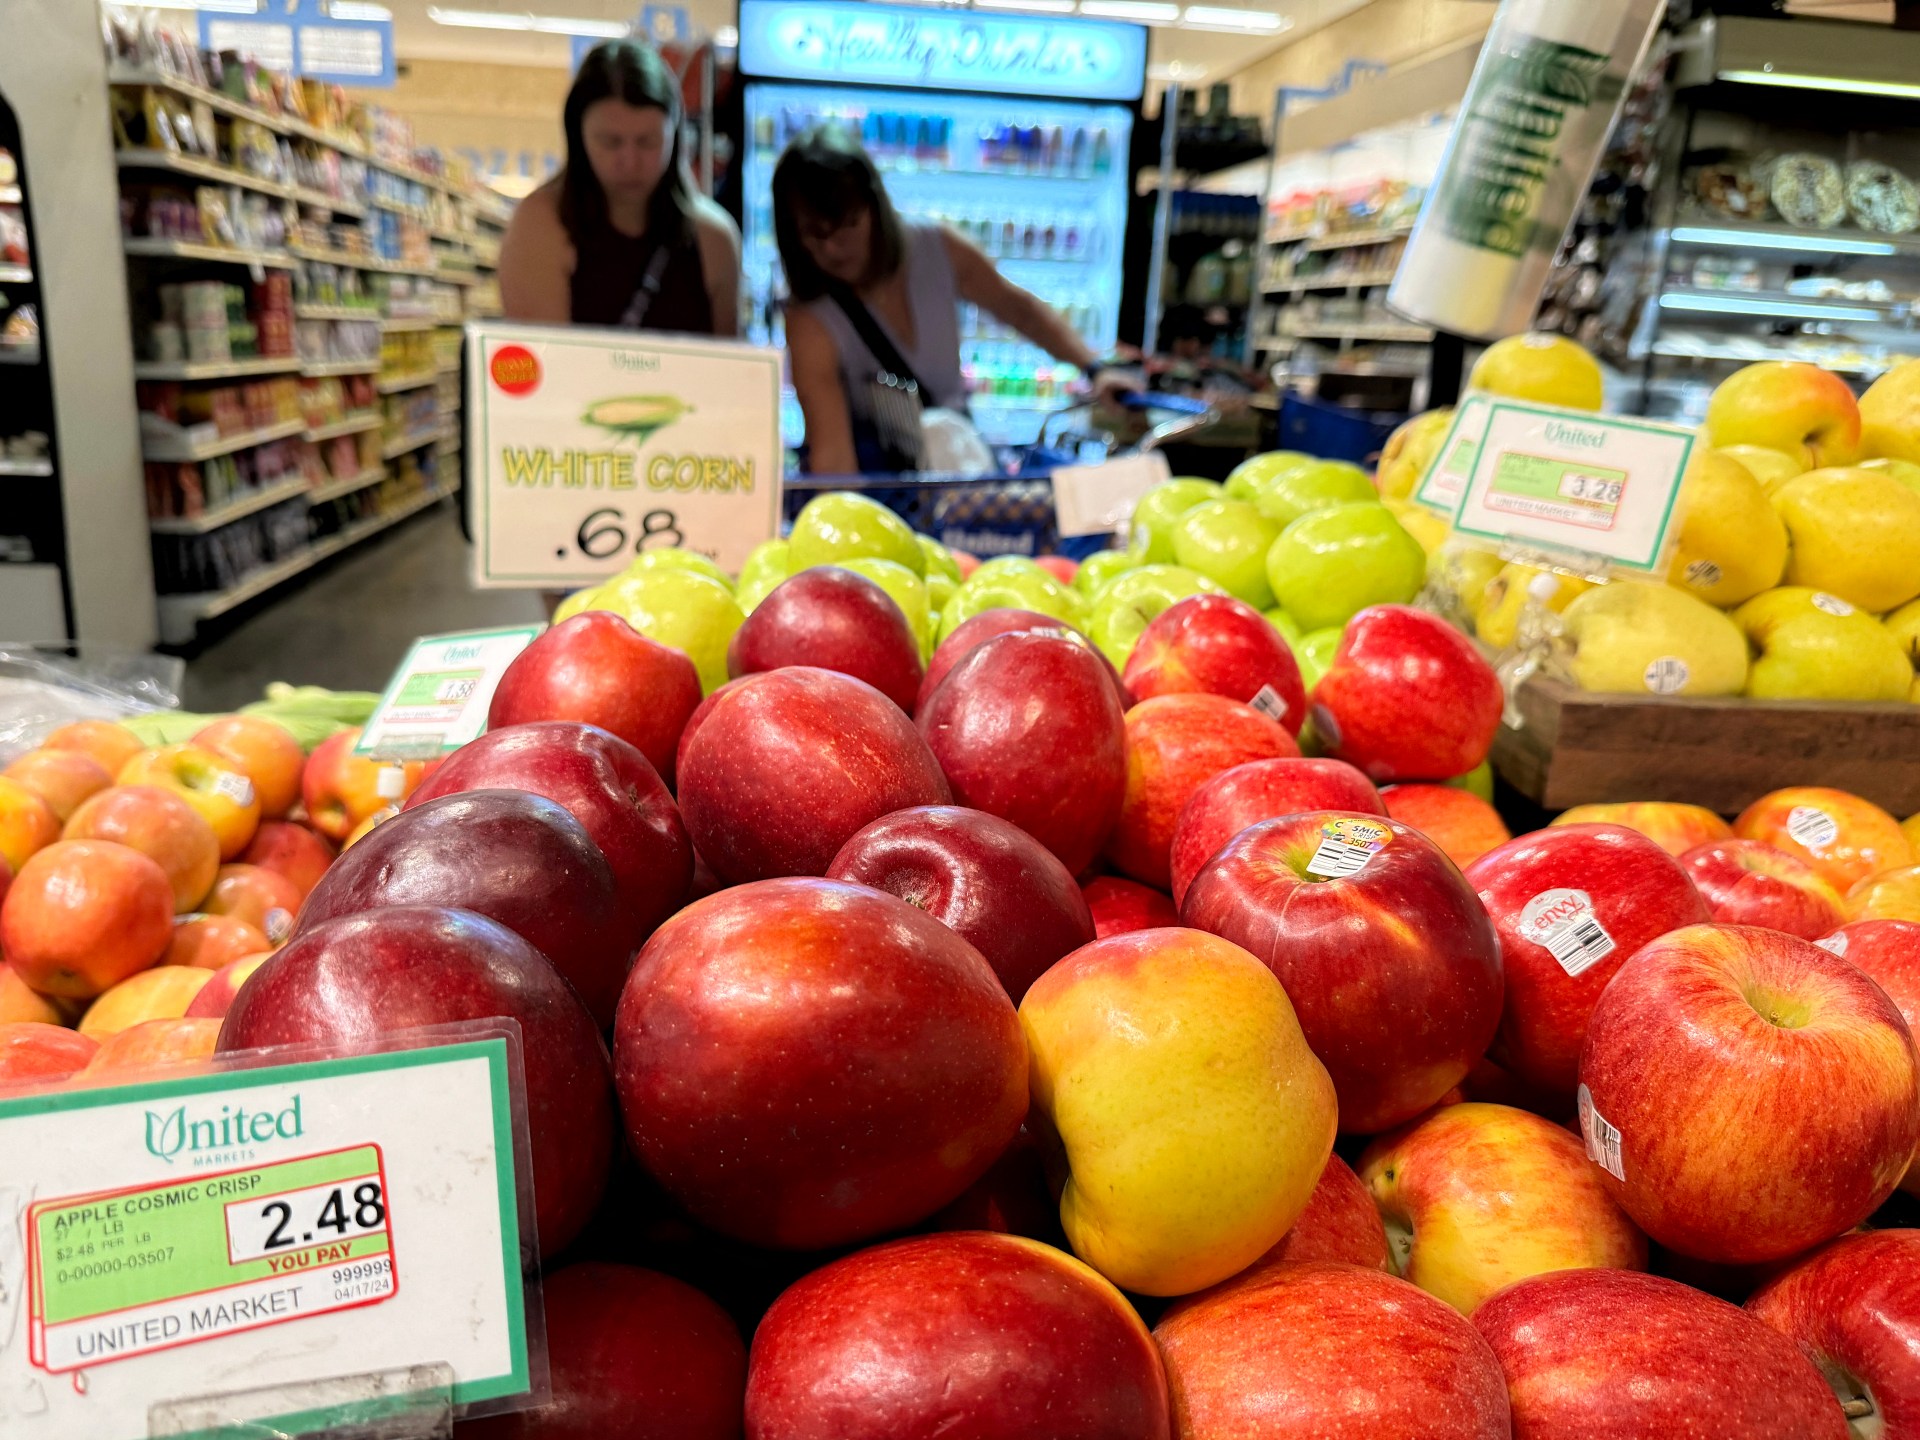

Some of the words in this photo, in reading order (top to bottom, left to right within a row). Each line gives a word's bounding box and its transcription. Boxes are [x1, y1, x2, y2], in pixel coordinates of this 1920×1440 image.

[1544, 421, 1608, 449] United
[502, 446, 637, 490] WHITE
[646, 452, 757, 494] CORN
[1571, 474, 1623, 503] 3.28
[555, 508, 684, 560] .68
[1348, 837, 1373, 849] 3507
[1534, 895, 1586, 929] envy
[145, 1094, 305, 1164] United
[193, 1151, 255, 1167] MARKETS
[54, 1203, 119, 1230] APPLE
[124, 1187, 200, 1214] COSMIC
[206, 1174, 262, 1198] CRISP
[261, 1181, 386, 1251] 2.48
[103, 1219, 124, 1236] LB
[103, 1236, 124, 1250] PER
[136, 1231, 152, 1244] LB
[57, 1246, 175, 1284] 0-00000-03507
[267, 1251, 311, 1273] YOU
[316, 1242, 352, 1264] PAY
[332, 1258, 393, 1284] 999999
[334, 1277, 390, 1302] 04/17/24
[76, 1314, 182, 1358] UNITED
[190, 1286, 303, 1332] MARKET
